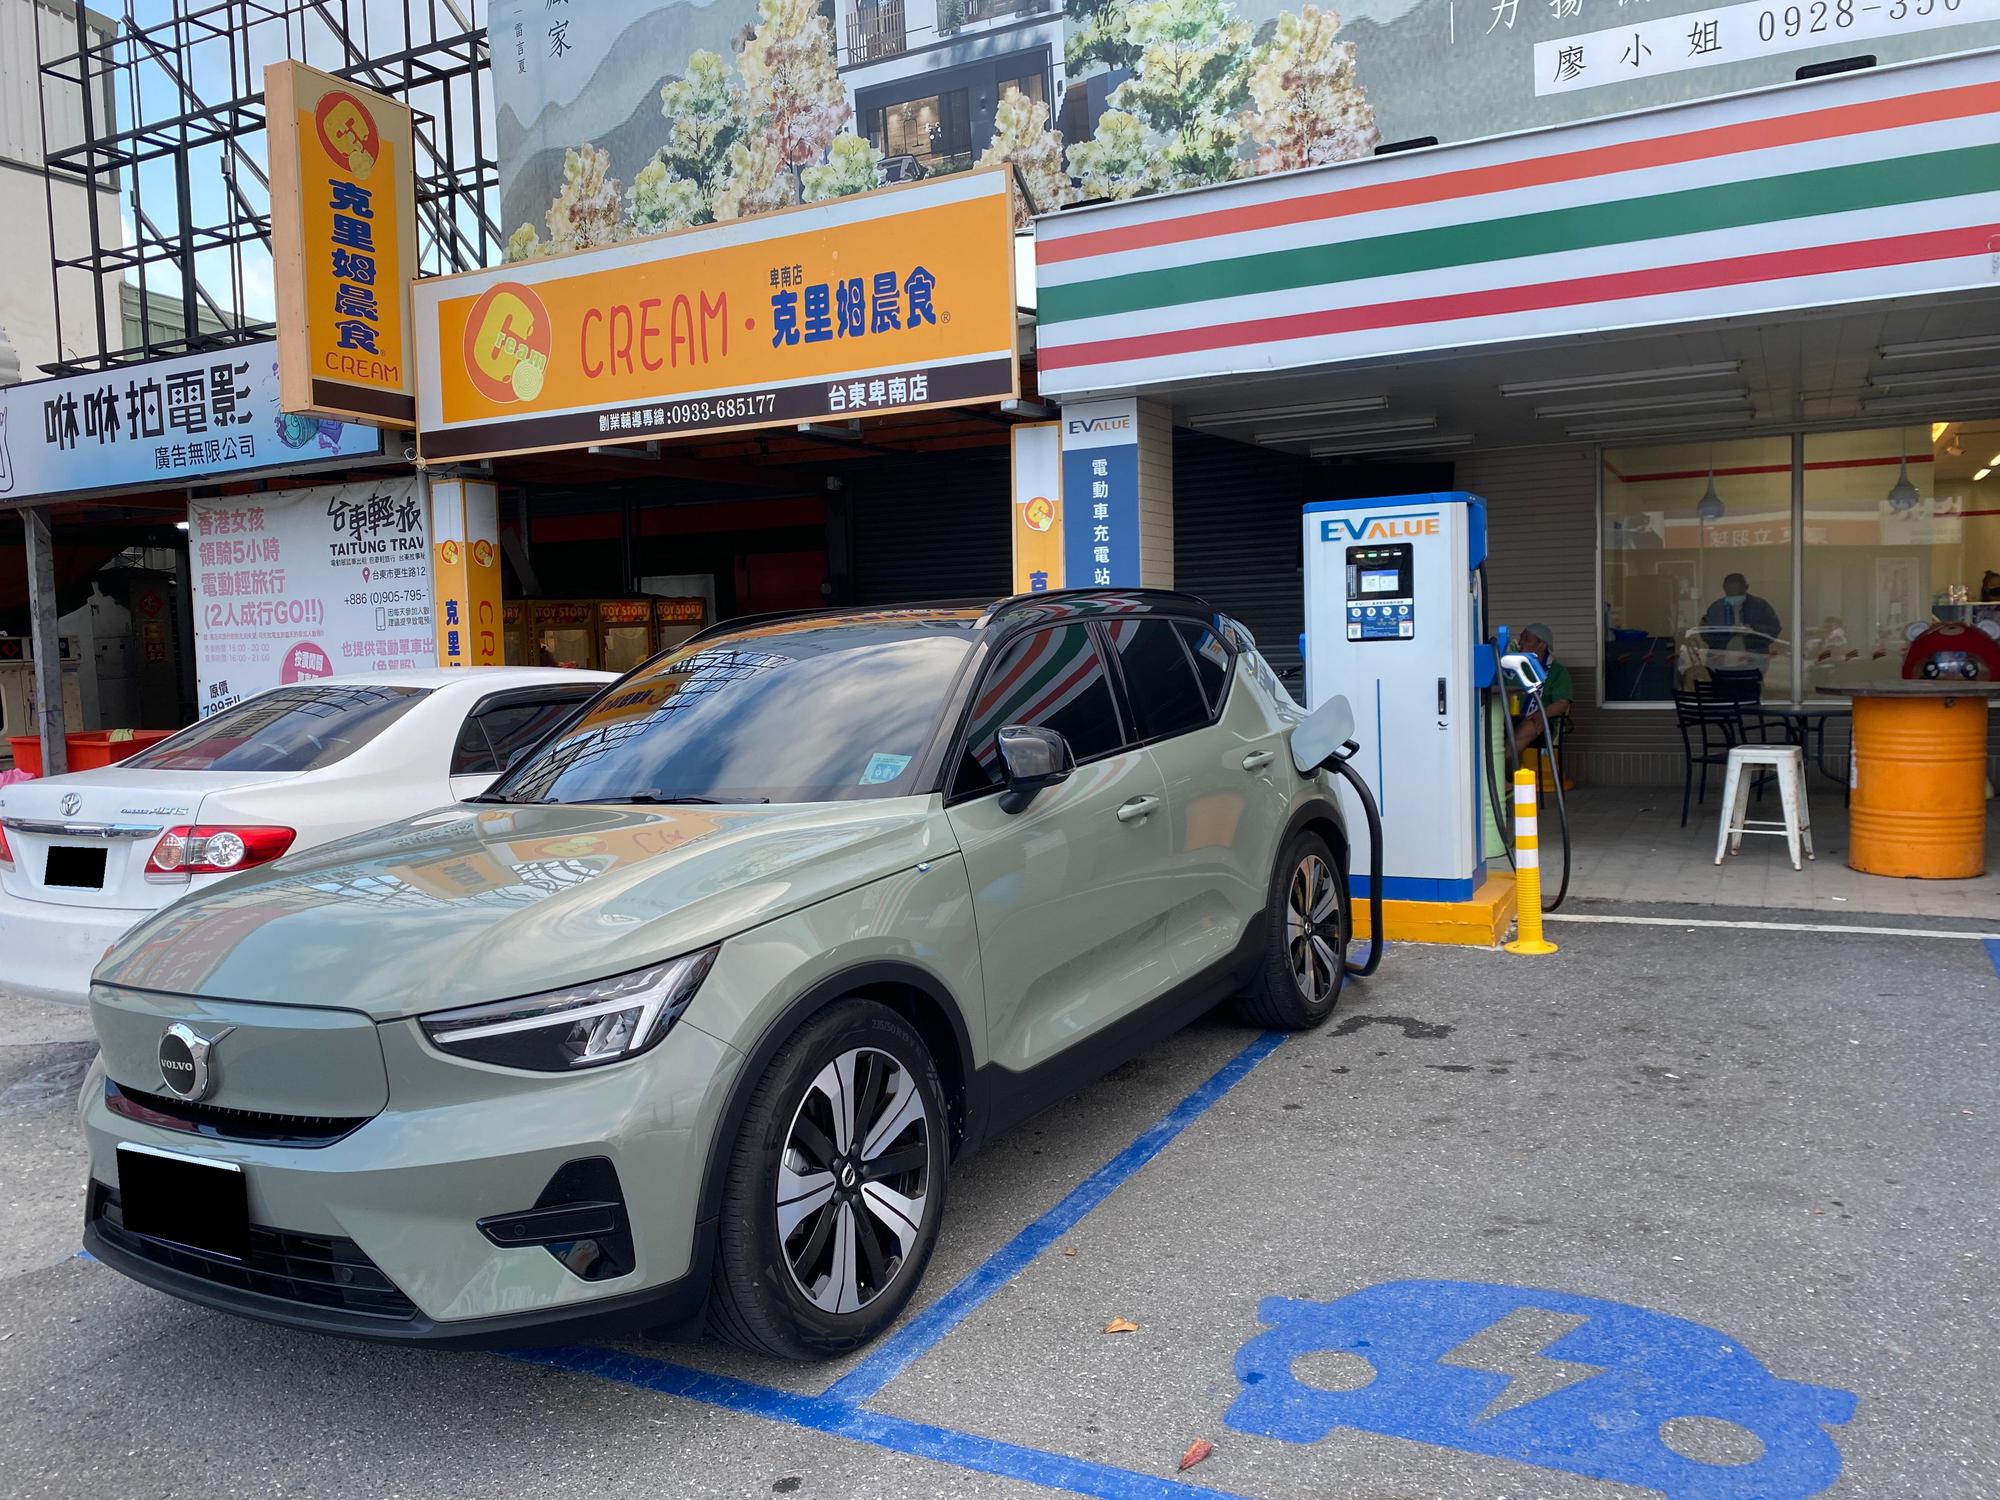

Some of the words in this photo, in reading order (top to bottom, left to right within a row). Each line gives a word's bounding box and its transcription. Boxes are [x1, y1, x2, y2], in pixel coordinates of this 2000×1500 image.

[545, 0, 573, 57] 家
[769, 263, 803, 289] 卑南店
[580, 290, 728, 379] CREAM
[326, 352, 398, 382] CREAM
[44, 360, 253, 450] 咻咻拍電影
[828, 373, 929, 411] 台東卑南店
[155, 434, 255, 470] 廣告無限公司
[197, 506, 265, 536] 香港女孩
[327, 493, 423, 541] 台東輕旅
[1091, 458, 1110, 586] 電動車充電站
[1320, 512, 1440, 543] EVALUE
[199, 537, 280, 567] 領騎5小時
[330, 539, 386, 556] TAITUNG
[201, 568, 286, 597] 電動輕旅行
[204, 598, 324, 630] (2人成行GO!!)
[344, 592, 367, 605] +886
[445, 599, 461, 666] 克里
[479, 600, 496, 666] CR
[209, 680, 229, 699] 原價
[160, 1058, 193, 1072] VOLVO
